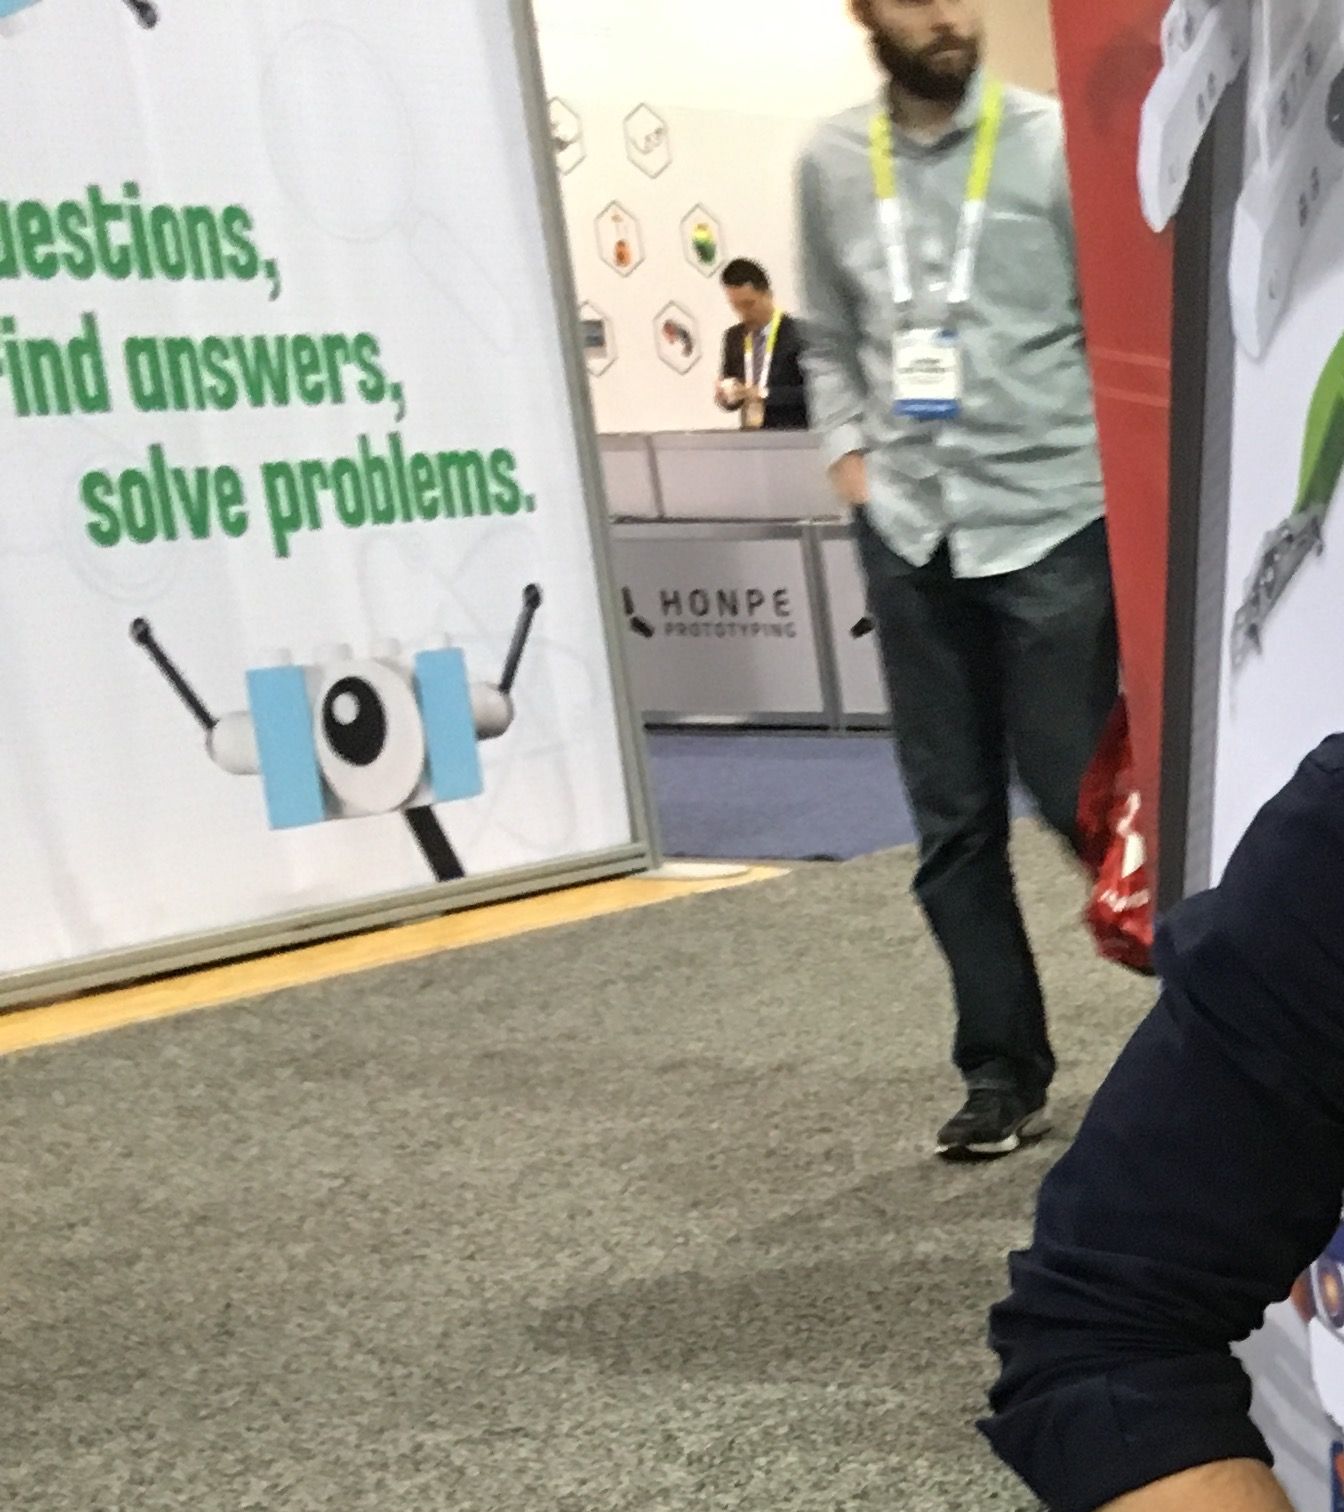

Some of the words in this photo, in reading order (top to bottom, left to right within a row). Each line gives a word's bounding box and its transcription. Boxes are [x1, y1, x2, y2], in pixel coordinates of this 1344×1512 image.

[0, 311, 112, 417] ind
[123, 331, 406, 423] answers,
[79, 442, 248, 548] solve
[260, 431, 536, 559] problems.
[659, 588, 790, 617] HONPE
[664, 621, 797, 639] PROTOTYPING
